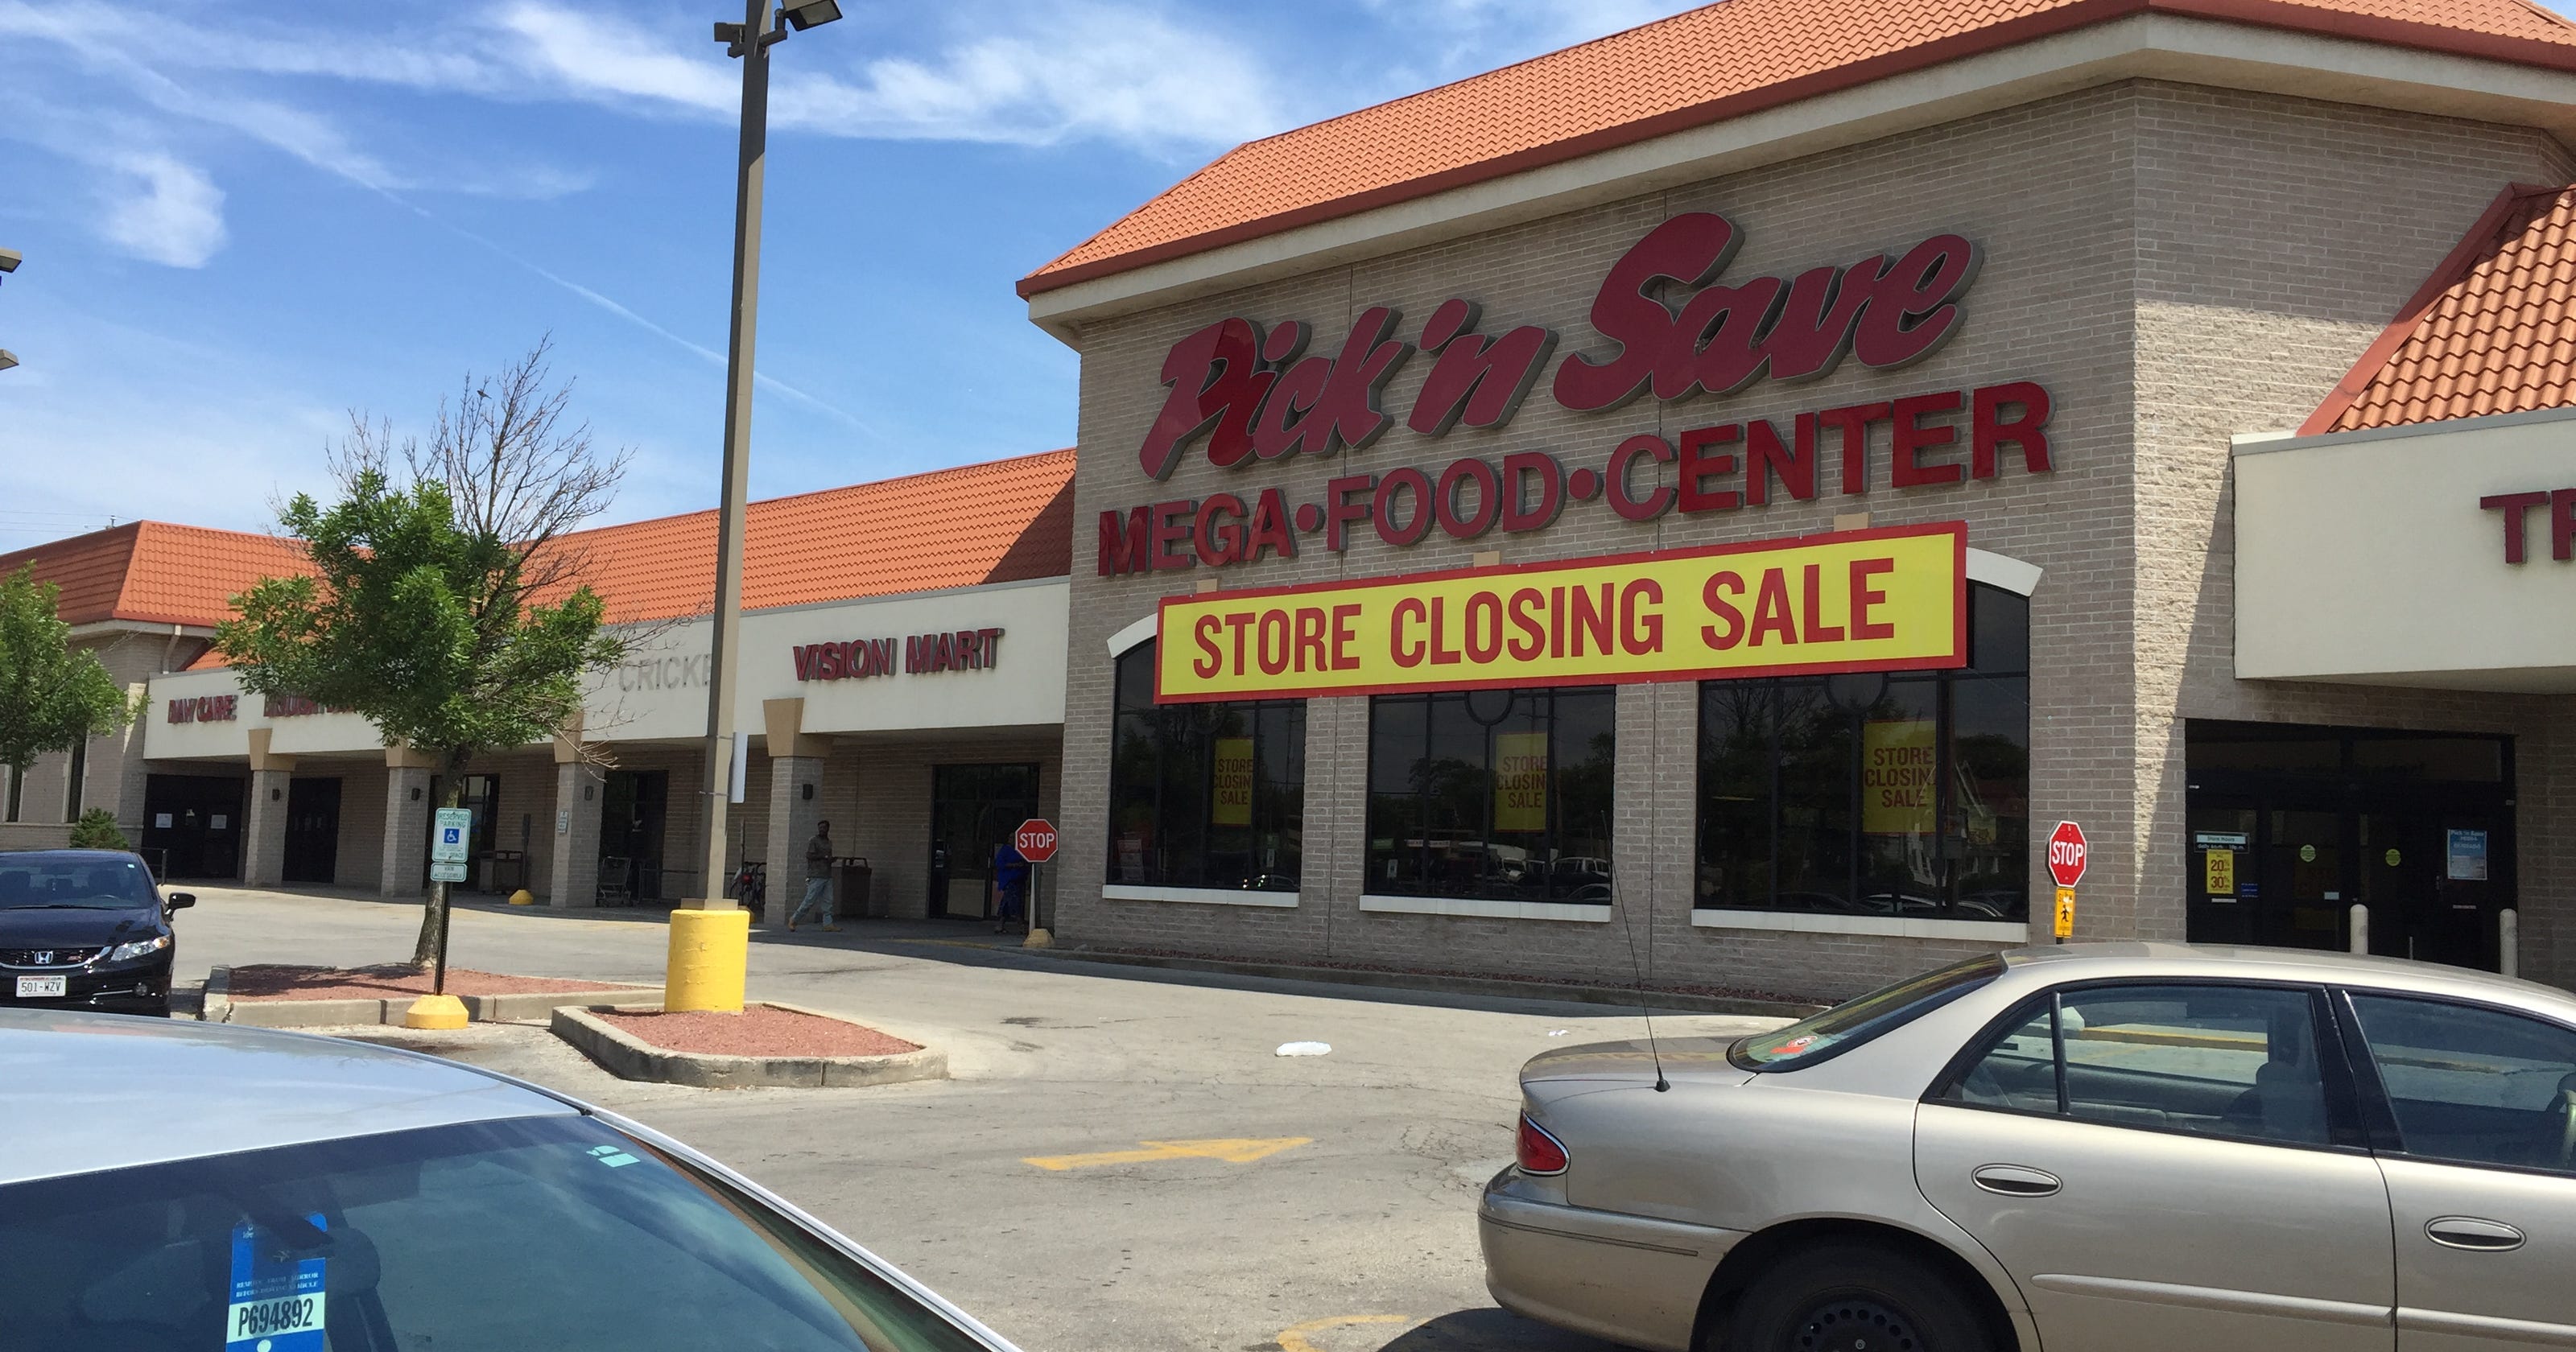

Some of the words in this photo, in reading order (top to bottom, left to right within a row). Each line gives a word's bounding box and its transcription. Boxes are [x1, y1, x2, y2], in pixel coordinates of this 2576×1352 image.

[1140, 306, 1415, 481] Pick
[1407, 298, 1558, 437] 'n
[1554, 212, 1984, 414] Save
[1098, 488, 1298, 576] MEGA
[1327, 452, 1567, 551] FOOD
[1605, 381, 2055, 521] CENTER
[1193, 604, 1362, 679] STORE
[1390, 578, 1663, 668] CLOSING
[1701, 558, 1894, 650] SALE
[793, 637, 898, 682] VISION
[906, 628, 1005, 674] MART
[196, 695, 238, 723] CARE
[1218, 758, 1253, 773] STORE
[1503, 756, 1547, 772] STORE
[1874, 747, 1934, 766] STORE
[1864, 768, 1936, 787] CLOSIN
[1220, 790, 1248, 805] SALE
[1508, 792, 1542, 809] SALE
[1881, 789, 1927, 808] SALE
[1019, 833, 1055, 848] STOP
[2052, 840, 2083, 866] STOP
[21, 982, 61, 992] 501-WZV
[238, 1298, 313, 1336] P694892
